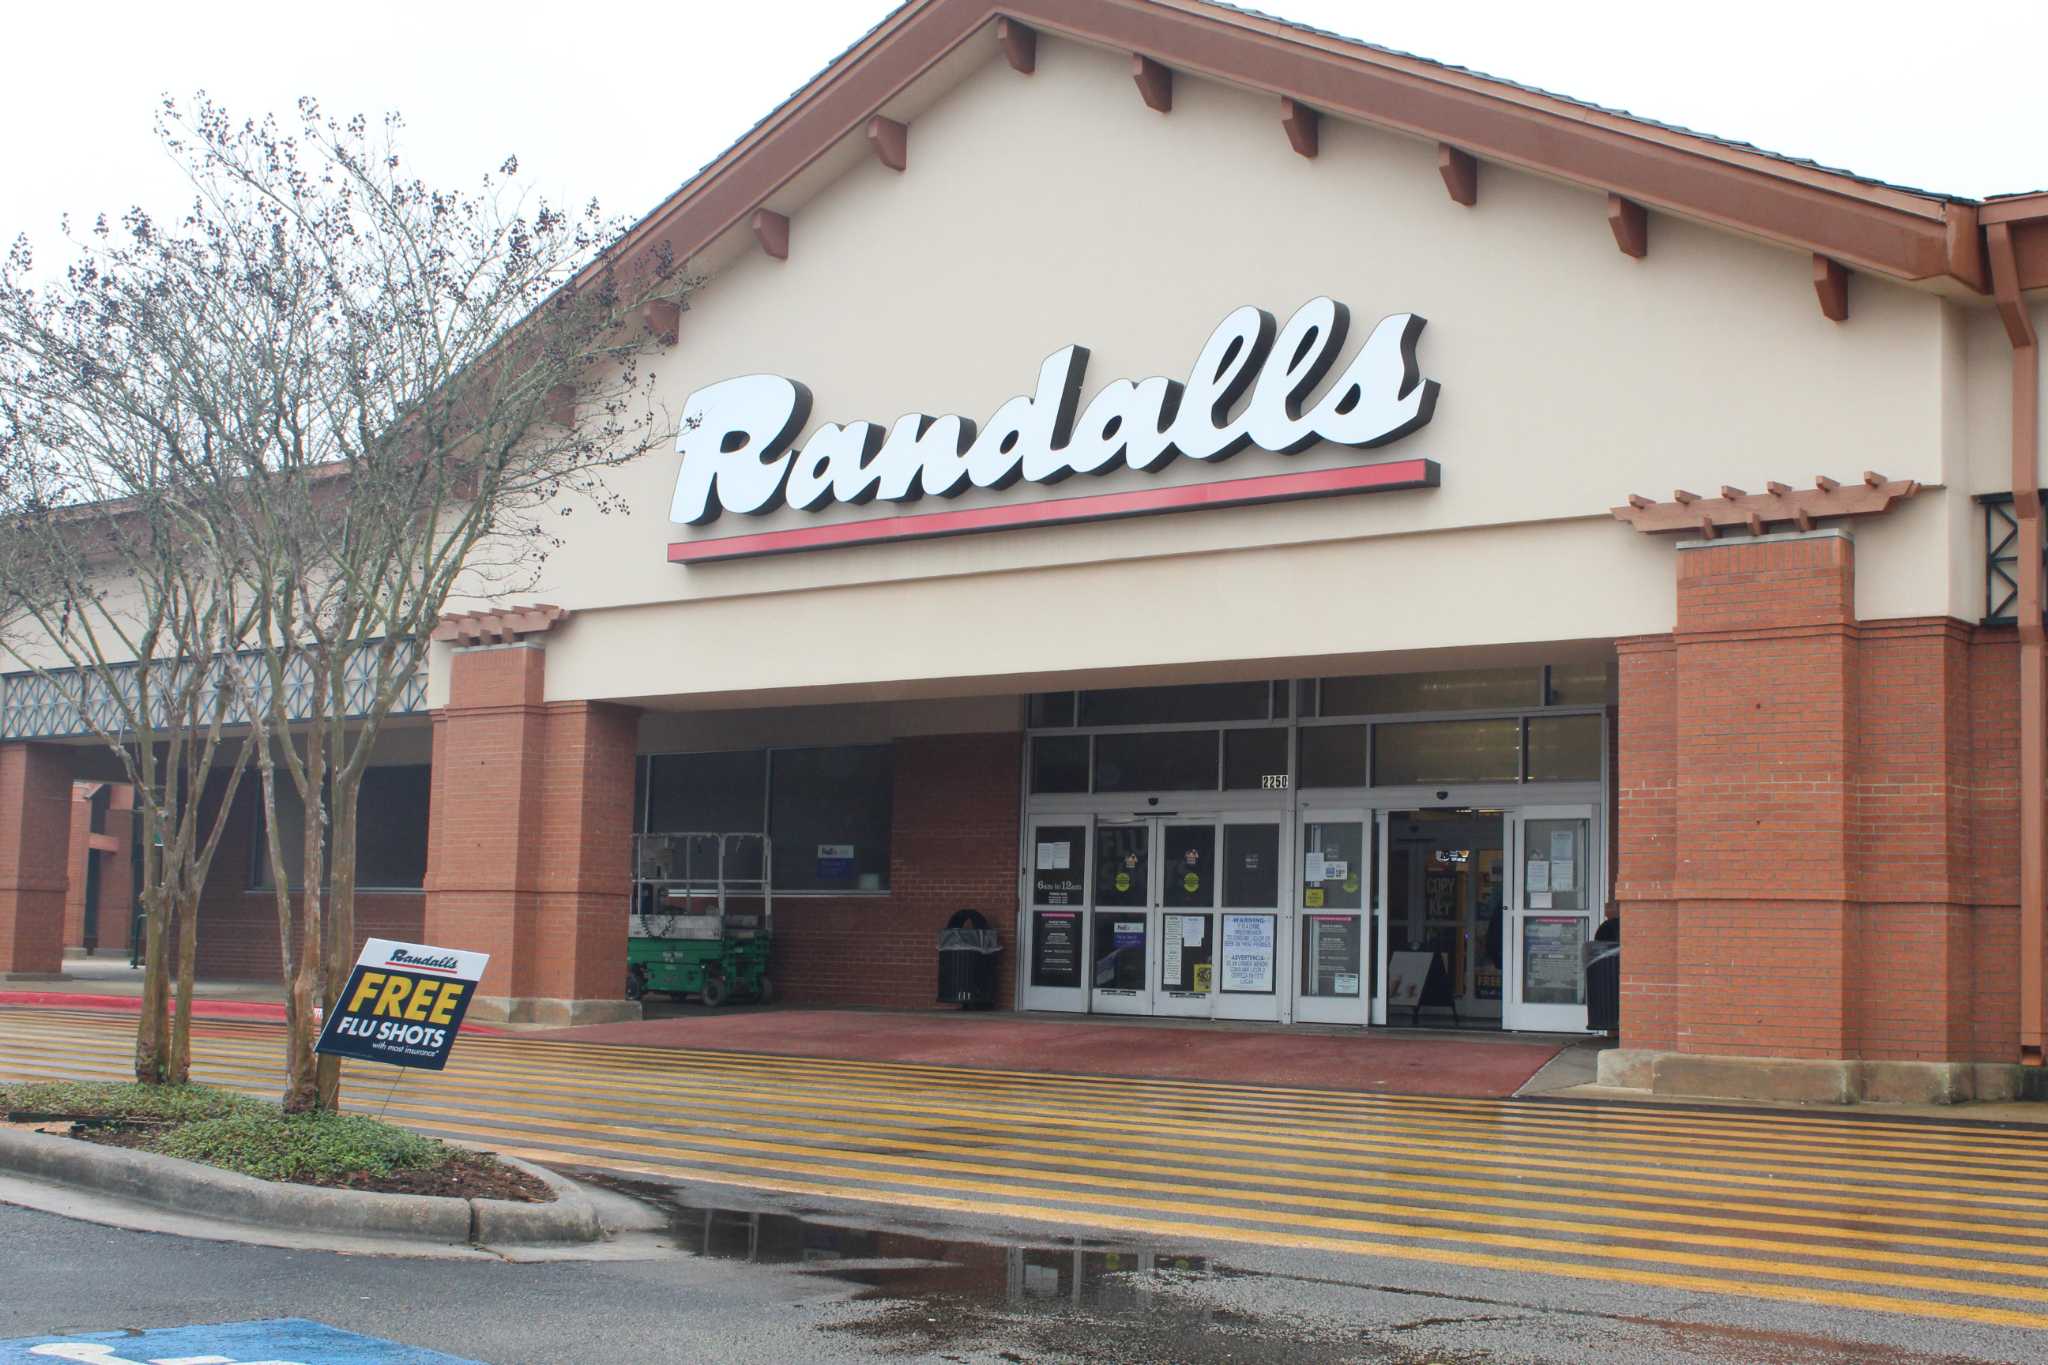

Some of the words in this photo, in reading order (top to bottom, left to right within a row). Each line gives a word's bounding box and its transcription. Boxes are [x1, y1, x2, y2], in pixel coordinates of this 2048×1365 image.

[668, 296, 1440, 526] Randalls
[1263, 775, 1287, 788] 2250
[390, 949, 457, 969] Randalls
[347, 971, 465, 1025] FREE
[336, 1017, 376, 1035] FLU
[376, 1022, 447, 1048] SHOTS
[372, 1042, 387, 1050] with
[387, 1045, 404, 1053] most
